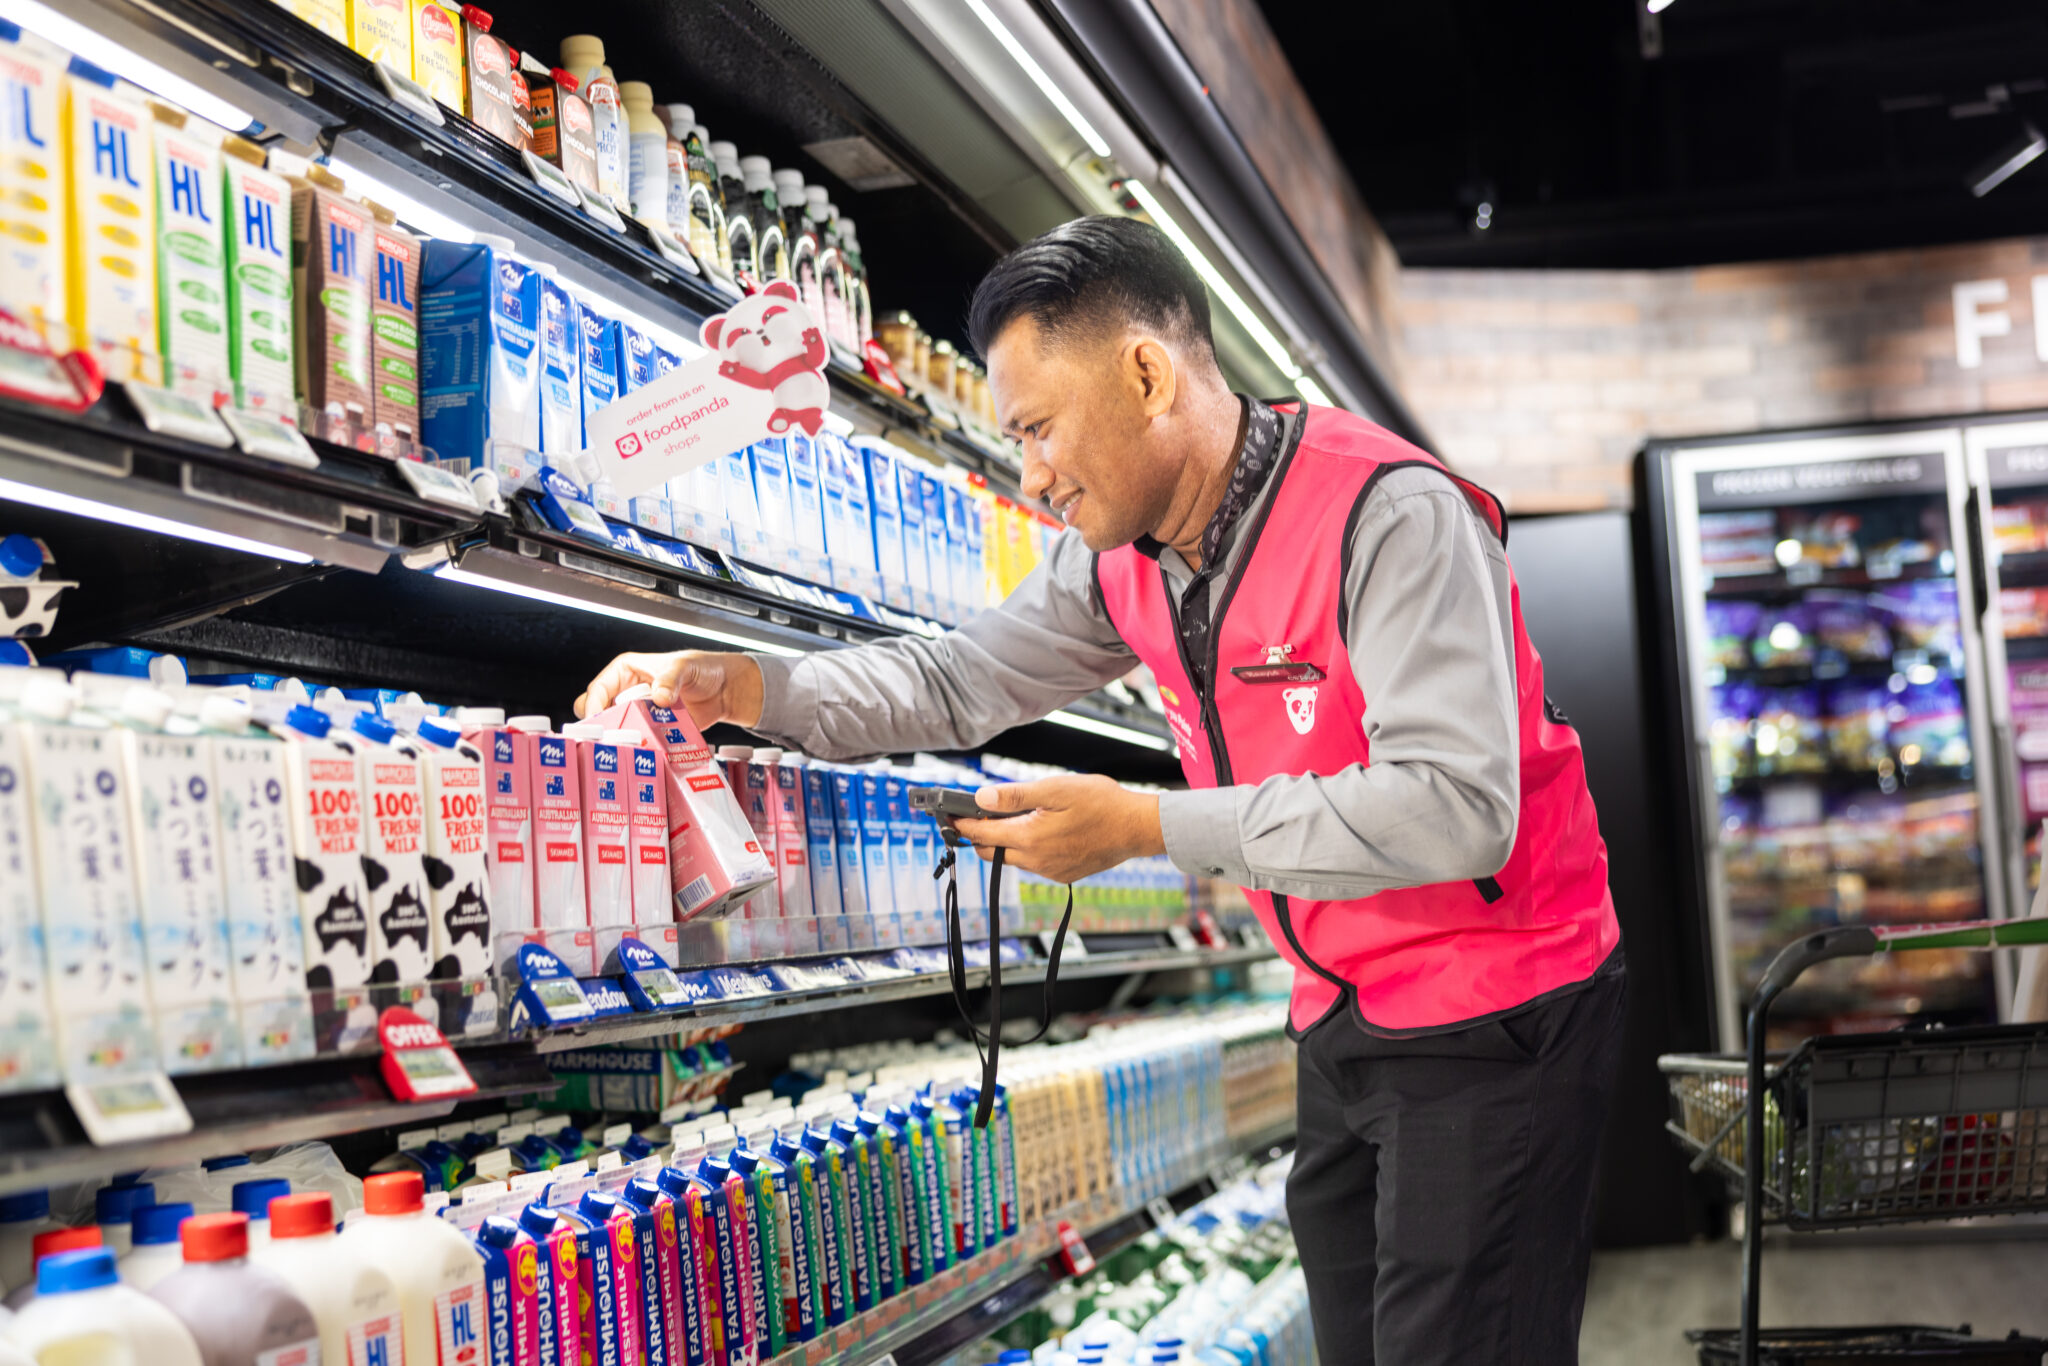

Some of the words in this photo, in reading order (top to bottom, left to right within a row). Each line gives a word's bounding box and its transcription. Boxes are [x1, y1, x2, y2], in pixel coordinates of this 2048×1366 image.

[475, 75, 511, 106] CHOCOLATE
[93, 119, 140, 189] HL
[564, 133, 596, 161] CHOCOLATE
[169, 159, 213, 224] HL
[245, 194, 283, 258] HL
[330, 222, 366, 285] HL
[378, 252, 413, 312] HL
[626, 408, 653, 426] order
[653, 397, 678, 412] from
[679, 389, 691, 402] us
[692, 384, 706, 395] on
[644, 396, 730, 444] foodpanda
[663, 432, 701, 457] shops
[667, 749, 712, 764] AUSTRALIAN
[309, 788, 360, 817] 100%
[374, 792, 422, 818] 100%
[440, 794, 484, 819] 100%
[692, 779, 720, 789] SKIMMED
[315, 818, 359, 836] FRESH
[379, 819, 422, 837] FRESH
[445, 819, 484, 838] FRESH
[490, 807, 527, 820] AUSTRALIAN
[539, 808, 580, 822] AUSTRALIAN
[591, 813, 628, 826] AUSTRALIAN
[633, 815, 667, 827] AUSTRALIAN
[320, 837, 357, 854] MILK
[385, 837, 419, 854] MILK
[450, 837, 482, 854] MILK
[550, 847, 575, 858] SKIMMED
[601, 849, 623, 859] SKIMMED
[643, 851, 664, 860] SKIMMED
[386, 916, 427, 930] Australian
[450, 914, 488, 927] Australian
[386, 1024, 442, 1048] OFFER
[545, 1051, 654, 1072] FARMHOUSE
[900, 1143, 922, 1272] FARMHOUSE
[924, 1135, 946, 1260] FARMHOUSE
[962, 1127, 975, 1247] FARMHOUSE
[765, 1211, 777, 1255] MILK
[818, 1171, 844, 1311] FARMHOUSE
[847, 1161, 871, 1296] FARMHOUSE
[869, 1151, 893, 1285] FARMHOUSE
[693, 1234, 706, 1285] MILK
[733, 1222, 747, 1271] MILK
[746, 1193, 769, 1343] FARMHOUSE
[788, 1180, 814, 1326] FARMHOUSE
[617, 1263, 630, 1318] MILK
[660, 1247, 673, 1300] MILK
[678, 1215, 701, 1358] FARMHOUSE
[716, 1204, 741, 1341] FARMHOUSE
[770, 1256, 780, 1290] FAT
[452, 1301, 477, 1348] HL
[492, 1276, 510, 1366] HOUSE
[537, 1261, 555, 1366] MHOUSE
[558, 1280, 571, 1337] MILK
[595, 1244, 616, 1366] RMHOUSE
[697, 1284, 710, 1351] FRESH
[739, 1271, 752, 1335] FRESH
[772, 1290, 785, 1337] LOW
[516, 1297, 528, 1357] MILK
[621, 1319, 633, 1366] ESH
